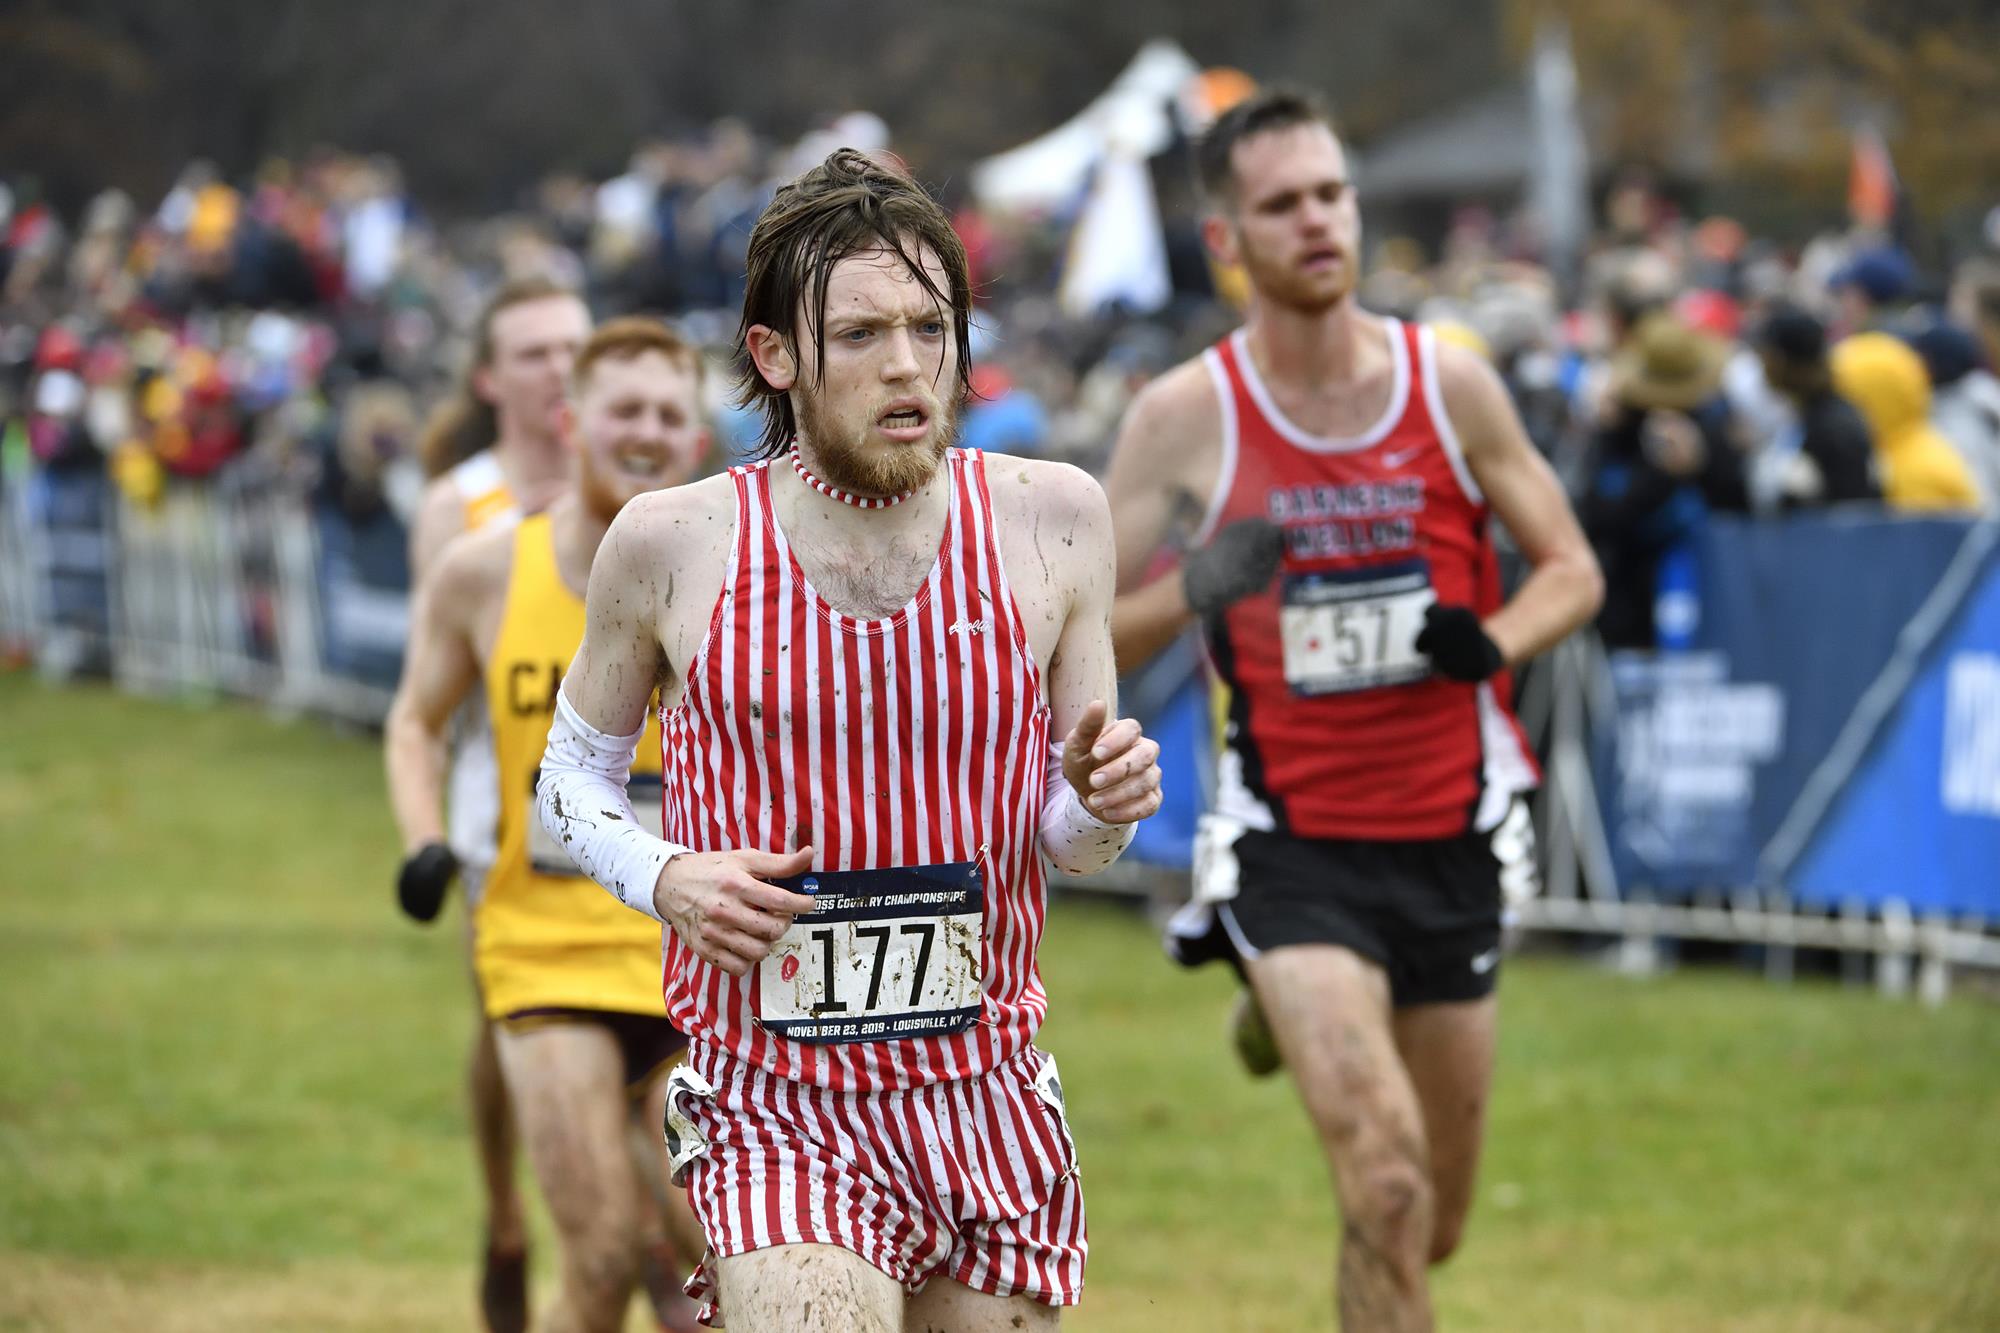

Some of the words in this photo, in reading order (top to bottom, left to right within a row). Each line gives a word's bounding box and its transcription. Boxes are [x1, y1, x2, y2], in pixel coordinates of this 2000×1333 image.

[1332, 602, 1390, 667] 57
[815, 899, 835, 910] OSS
[884, 891, 966, 906] CHAMPIONSHIPS
[812, 923, 935, 1013] 177
[843, 1024, 859, 1036] 23,
[861, 1022, 885, 1035] 2019
[893, 1017, 947, 1031] LOUISVILLE,
[949, 1014, 963, 1026] KY
